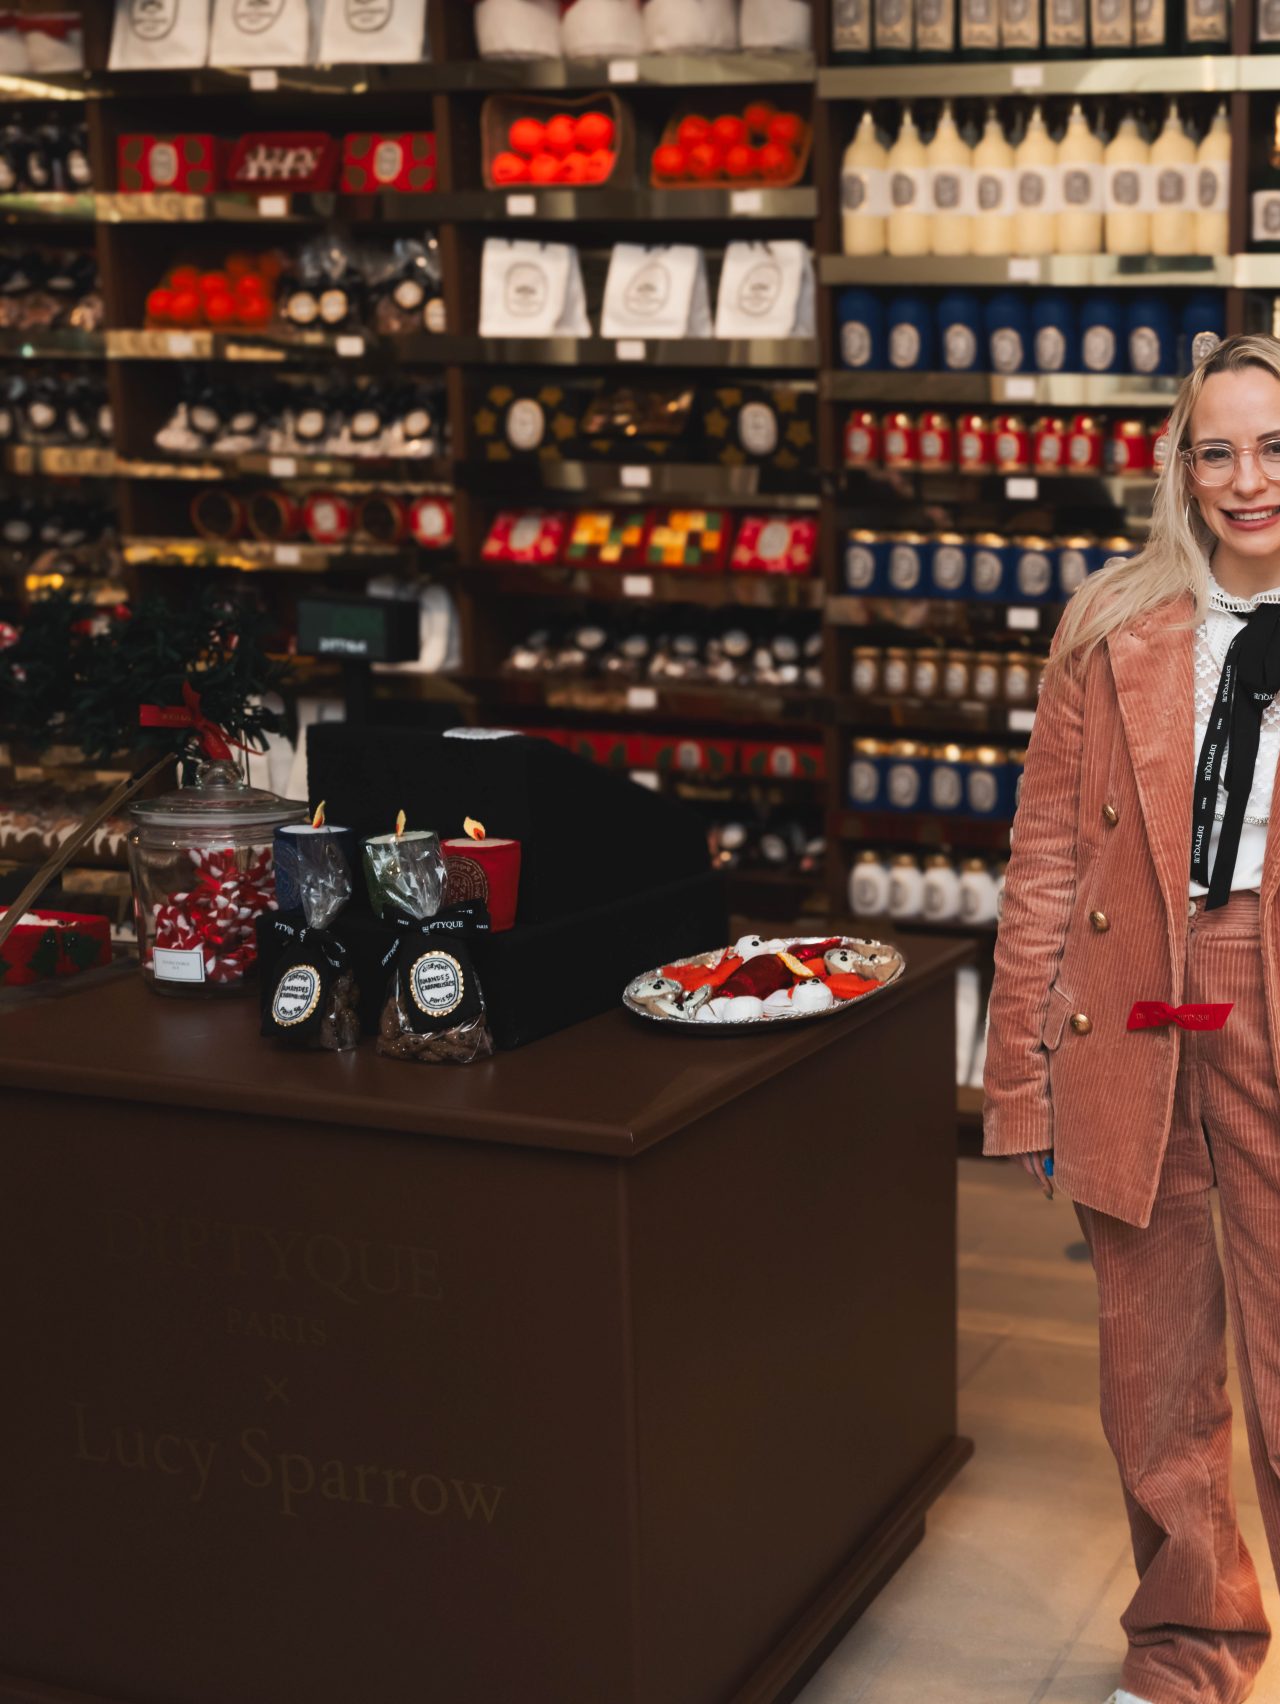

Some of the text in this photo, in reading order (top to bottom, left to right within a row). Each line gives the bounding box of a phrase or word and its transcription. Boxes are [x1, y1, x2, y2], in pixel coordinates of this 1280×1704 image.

[1204, 743, 1217, 782] DIPTYQUE
[1193, 825, 1205, 864] DIPTYQUE
[96, 1208, 443, 1305] DIPTYQUE
[225, 1307, 329, 1348] PARIS
[68, 1400, 507, 1525] Lucy Sparrow
